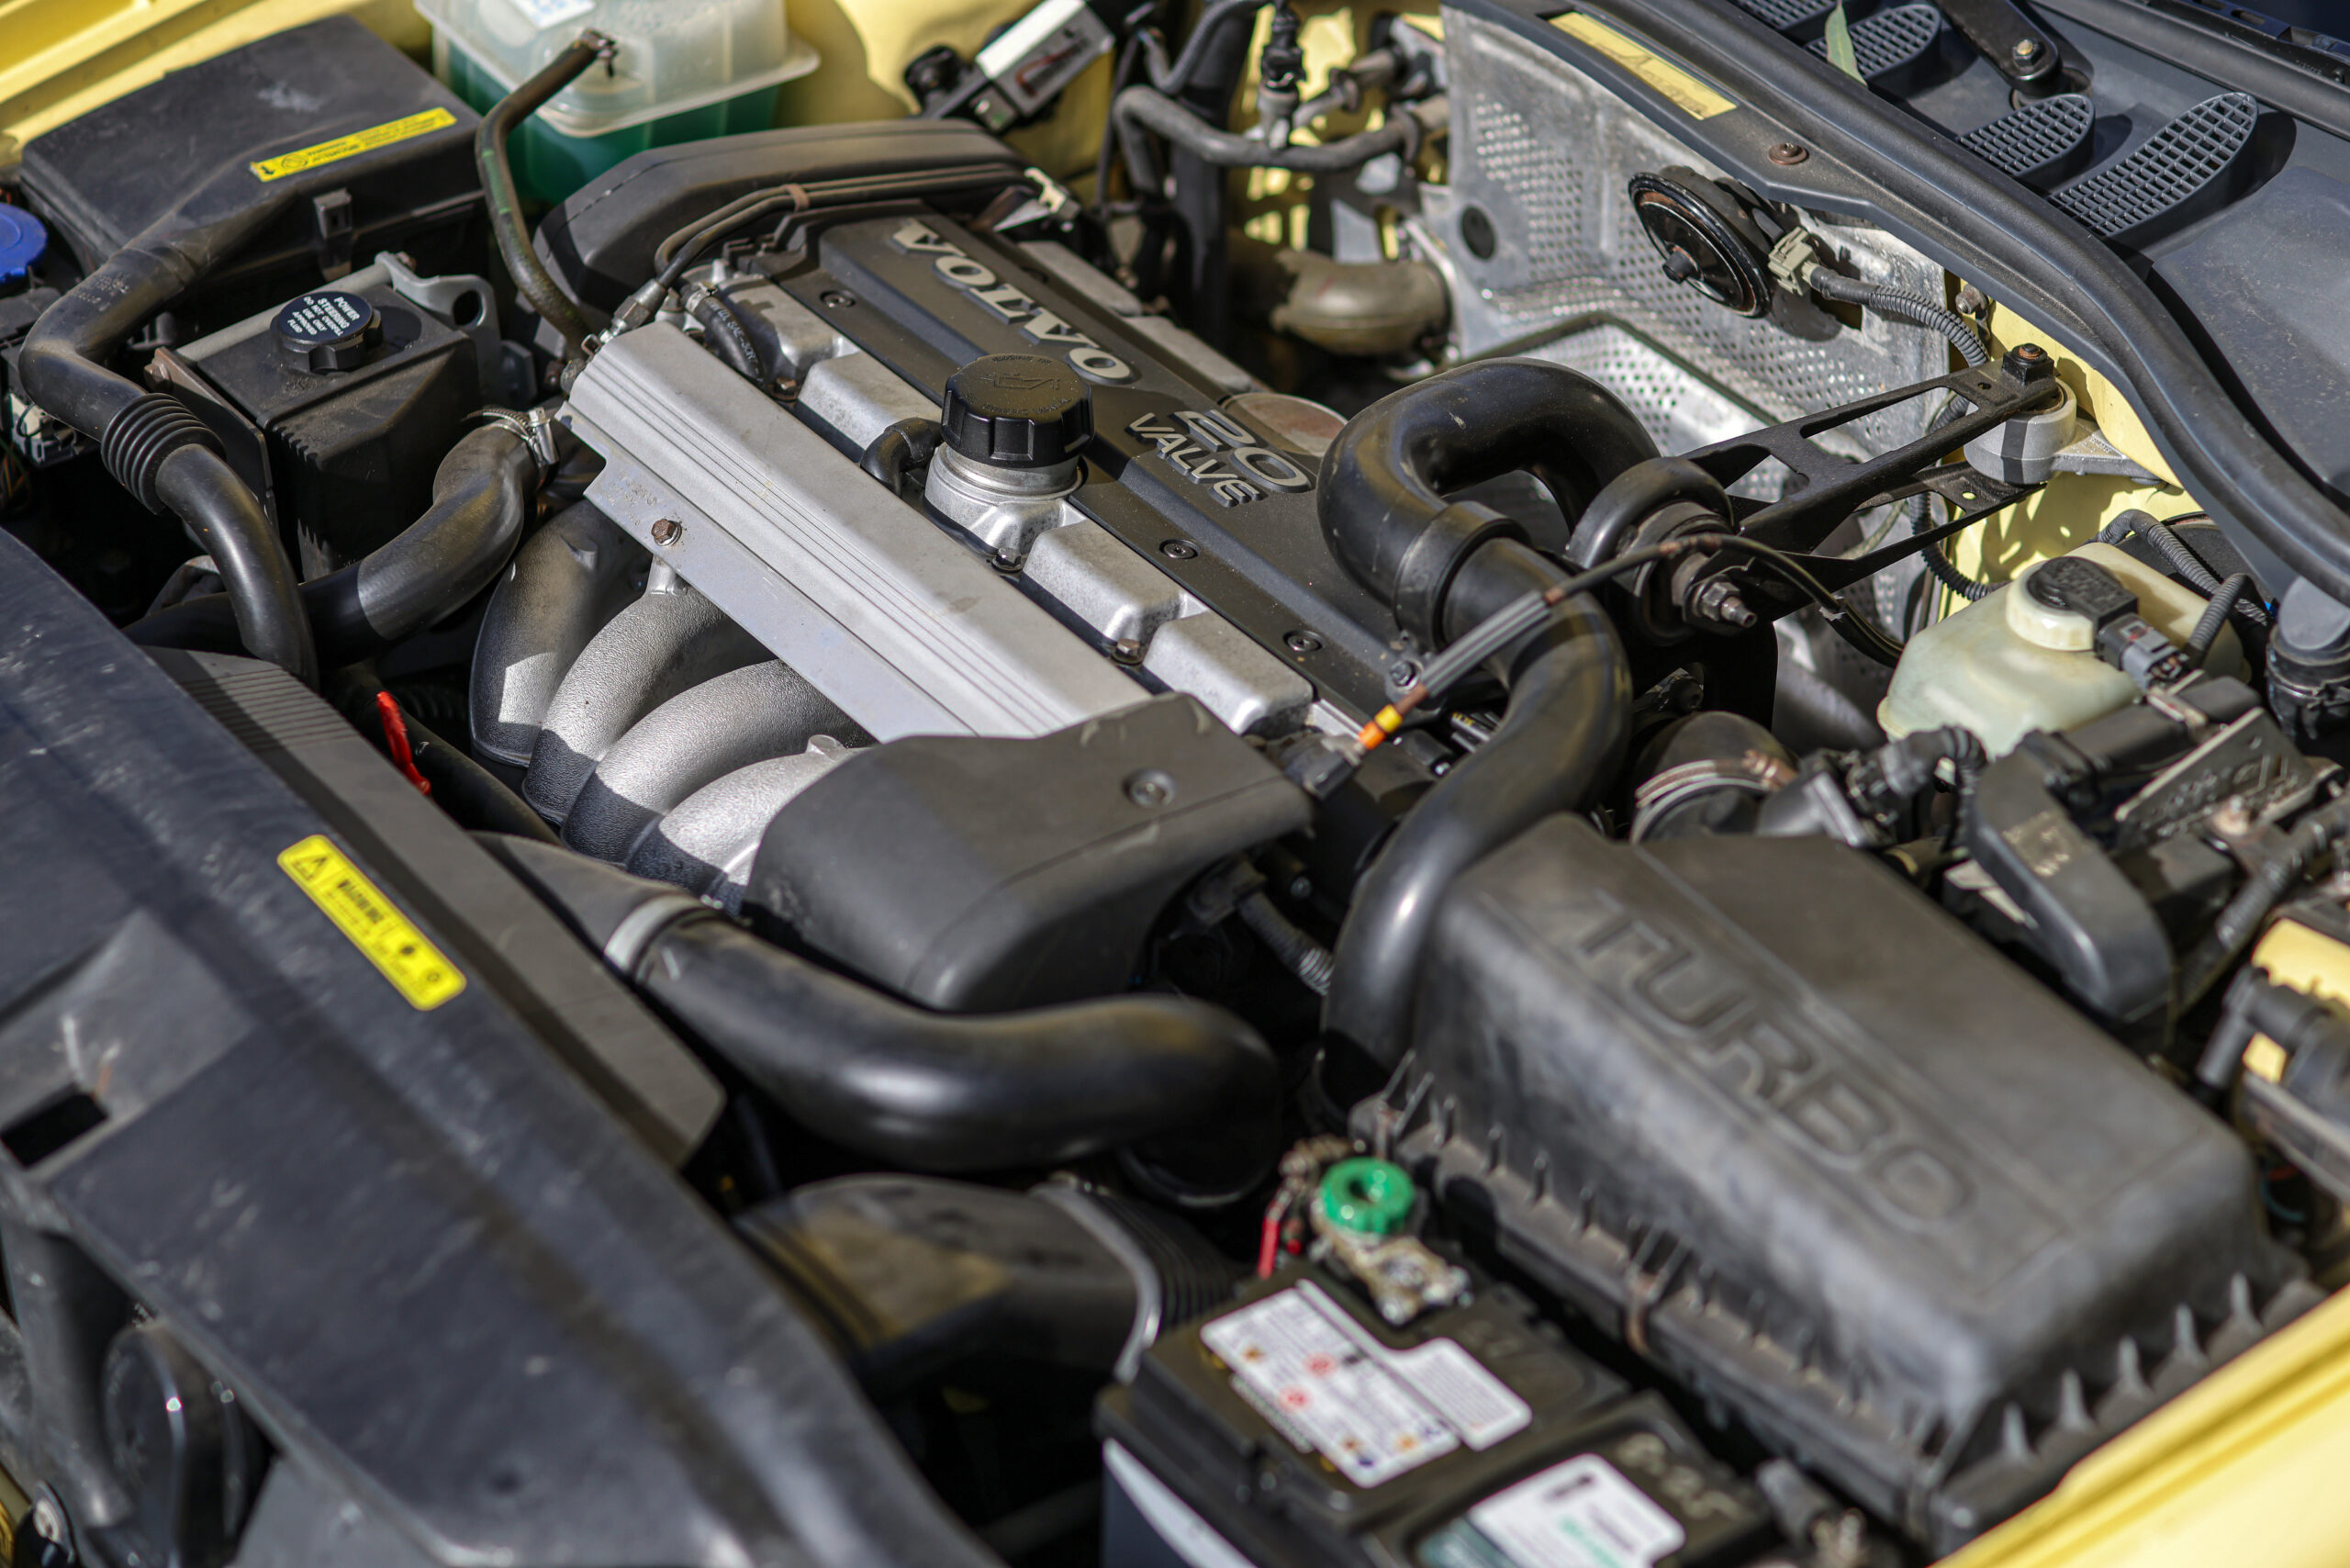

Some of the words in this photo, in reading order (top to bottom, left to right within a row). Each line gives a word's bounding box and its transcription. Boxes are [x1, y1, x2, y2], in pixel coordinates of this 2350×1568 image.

[302, 308, 316, 319] USE
[312, 319, 328, 331] ONLY
[303, 296, 315, 306] DO
[310, 304, 325, 316] NOT
[321, 315, 344, 337] OVERFILL
[317, 297, 351, 330] STEERING
[333, 296, 361, 321] POWER
[890, 218, 1133, 381] VOLVO
[286, 318, 303, 333] FLUID
[1127, 411, 1262, 504] VALVE
[1171, 409, 1313, 489] 20
[1571, 886, 1979, 1233] TURBO
